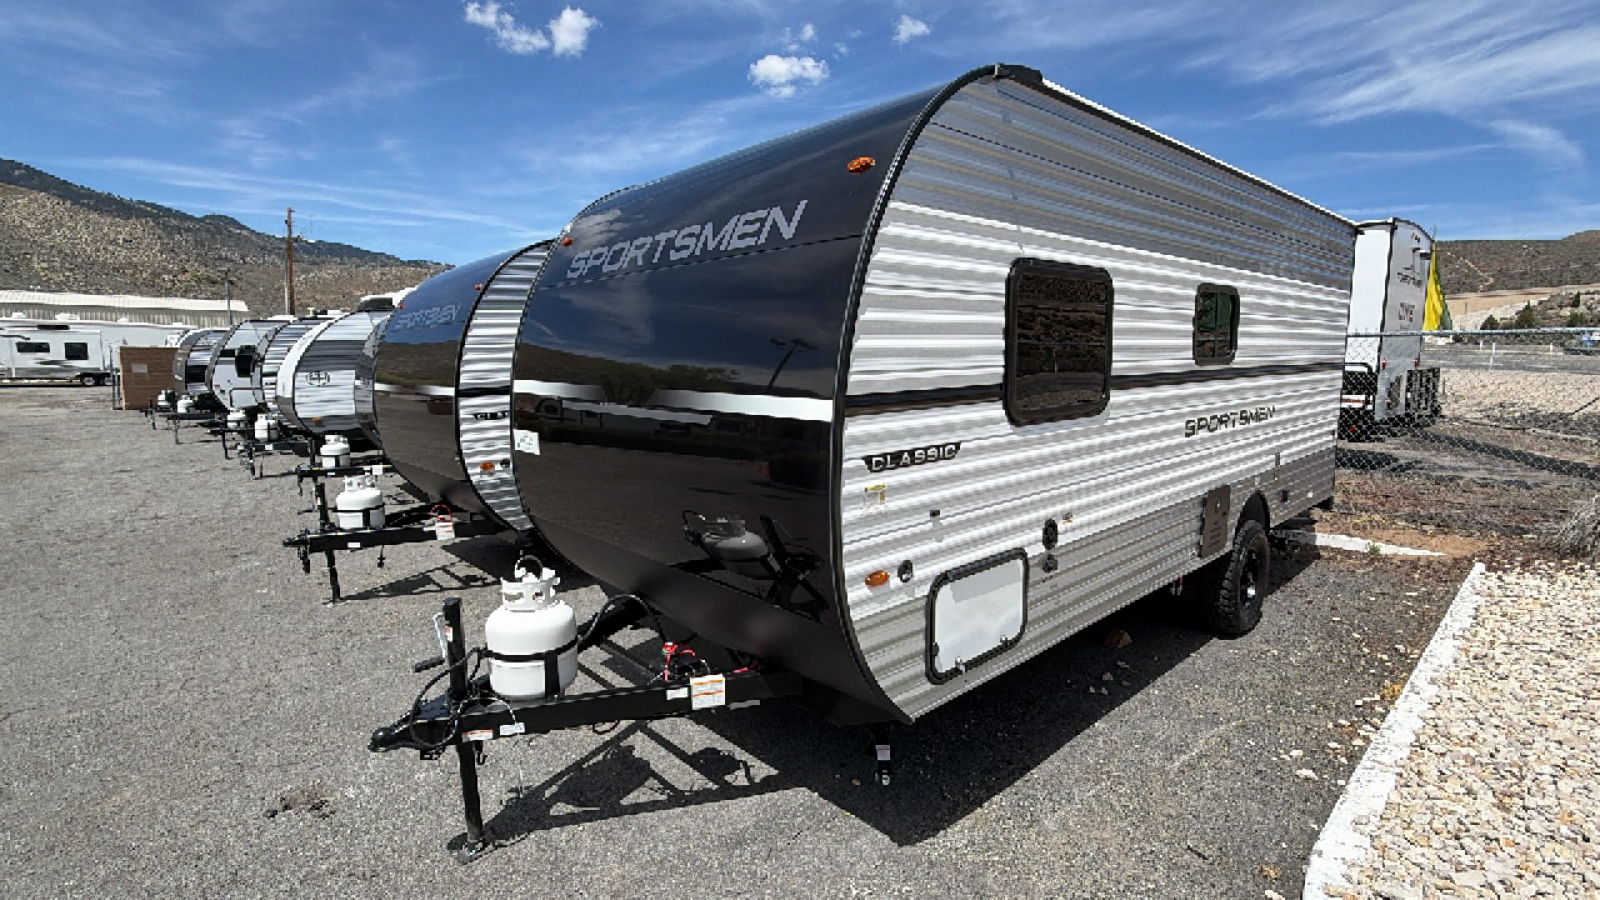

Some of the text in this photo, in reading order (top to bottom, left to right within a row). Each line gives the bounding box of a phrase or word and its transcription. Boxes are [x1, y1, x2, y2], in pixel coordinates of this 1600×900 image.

[566, 199, 808, 279] SPORTSMEN
[1184, 405, 1276, 438] SPORTSMEN
[871, 444, 956, 471] CLASSIC
